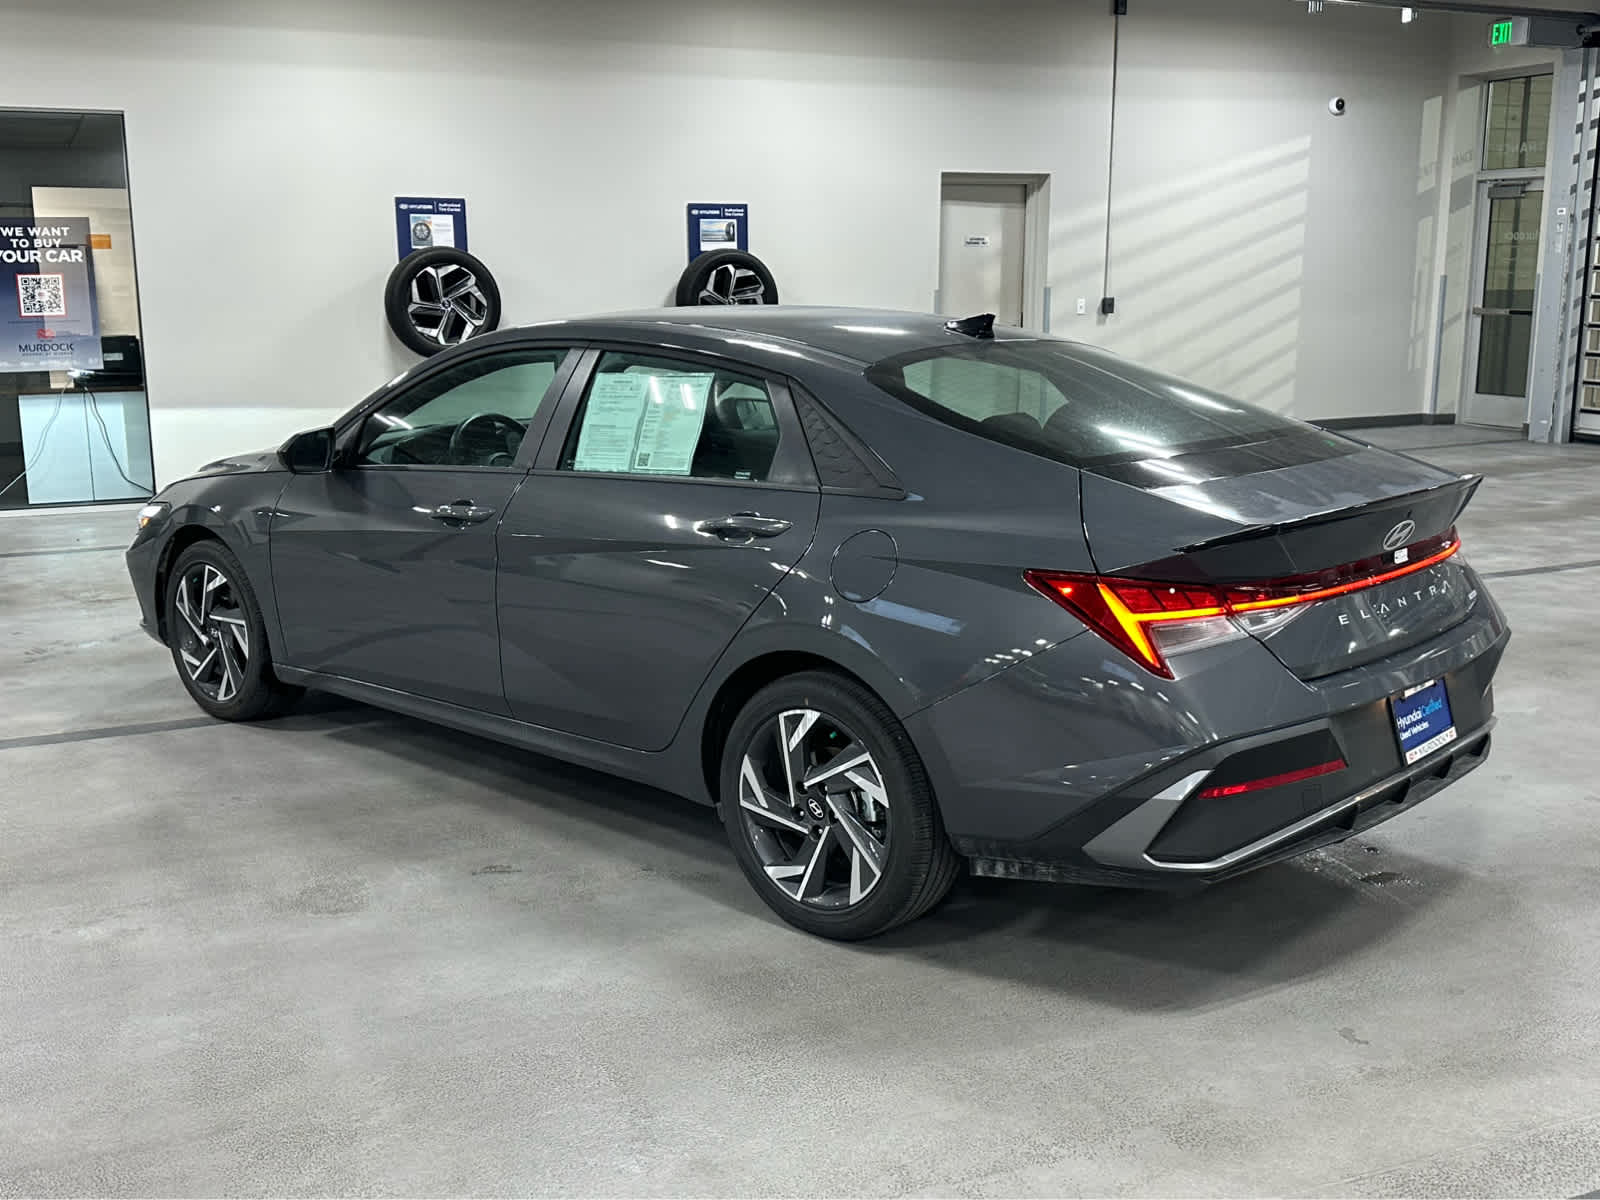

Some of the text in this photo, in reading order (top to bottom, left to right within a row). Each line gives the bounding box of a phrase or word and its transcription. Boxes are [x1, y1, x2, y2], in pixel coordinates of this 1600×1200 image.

[0, 227, 70, 236] WE WANT
[10, 238, 62, 248] TO BUY
[0, 250, 83, 263] OUR CAR
[18, 343, 74, 353] MURDOCK
[1338, 580, 1451, 625] ELANTRA
